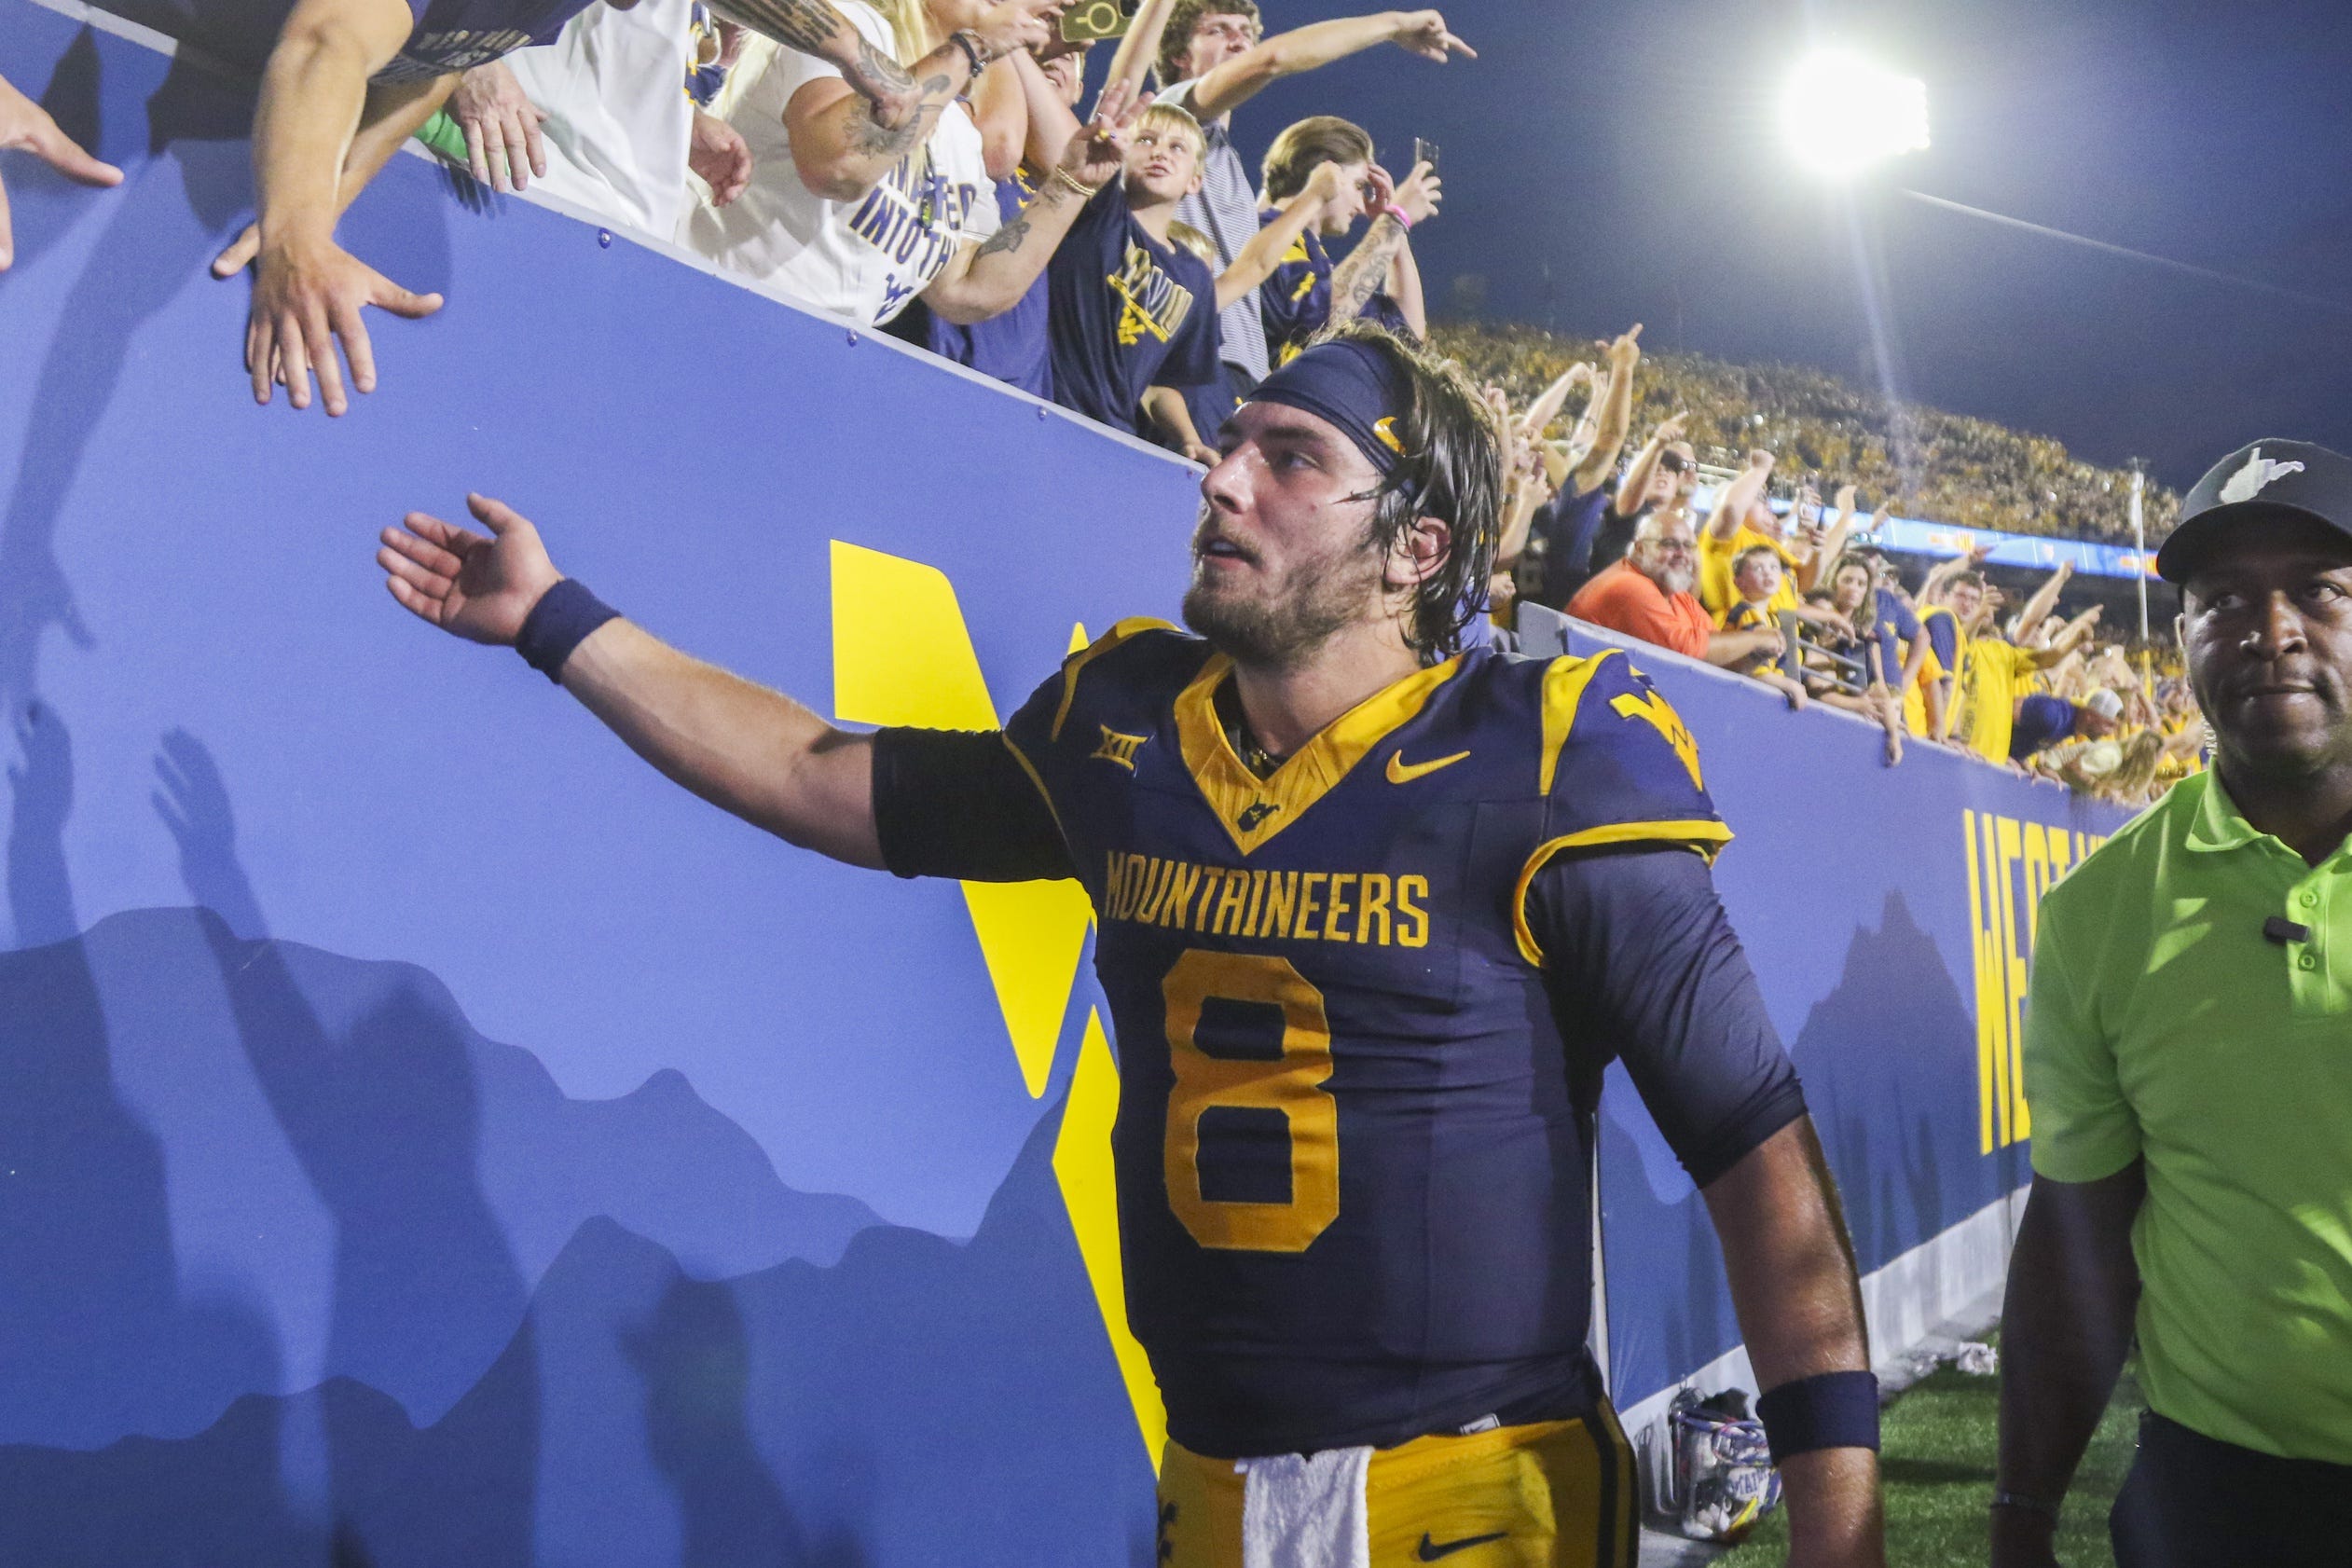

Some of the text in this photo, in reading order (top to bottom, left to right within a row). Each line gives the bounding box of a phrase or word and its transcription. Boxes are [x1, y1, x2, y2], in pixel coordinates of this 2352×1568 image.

[848, 186, 922, 266] INTO
[1104, 849, 1429, 948] MOUNTAINEERS
[1162, 948, 1340, 1253] 8
